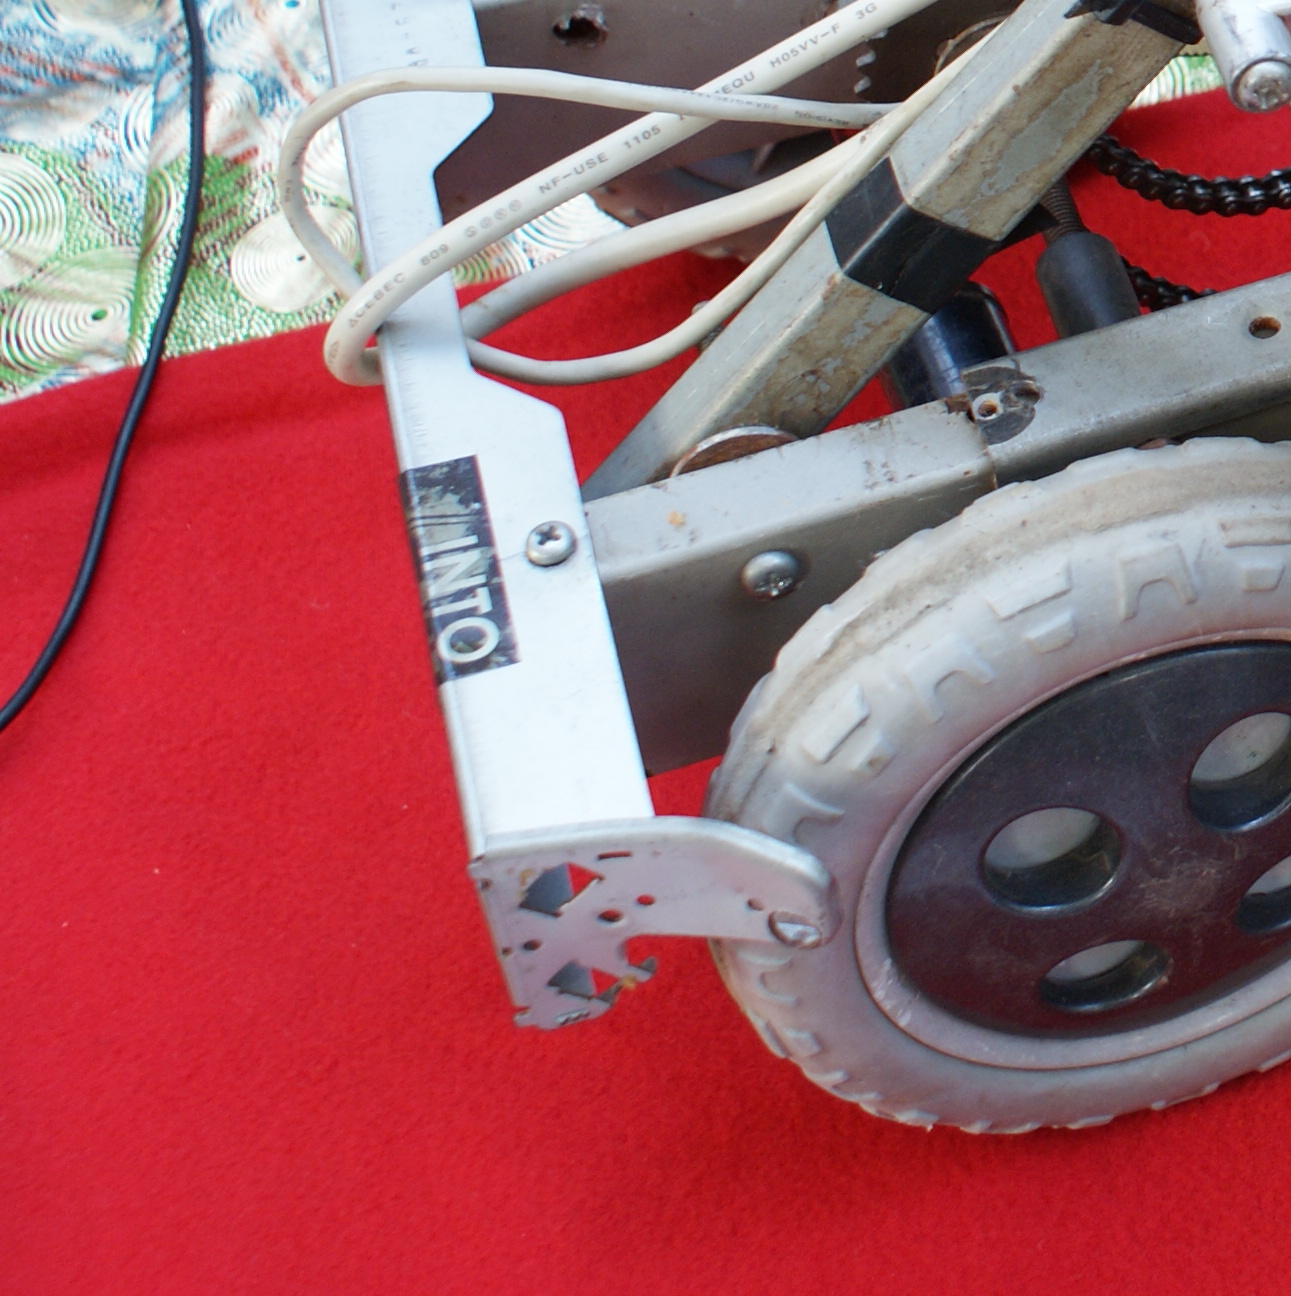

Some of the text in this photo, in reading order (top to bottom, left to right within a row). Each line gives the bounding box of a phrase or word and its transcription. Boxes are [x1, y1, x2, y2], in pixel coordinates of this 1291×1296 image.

[538, 151, 610, 196] NF-USE
[622, 124, 663, 151] 1105
[769, 22, 842, 69] H05VV-F
[854, 2, 879, 21] 3G
[419, 534, 501, 664] INTO
